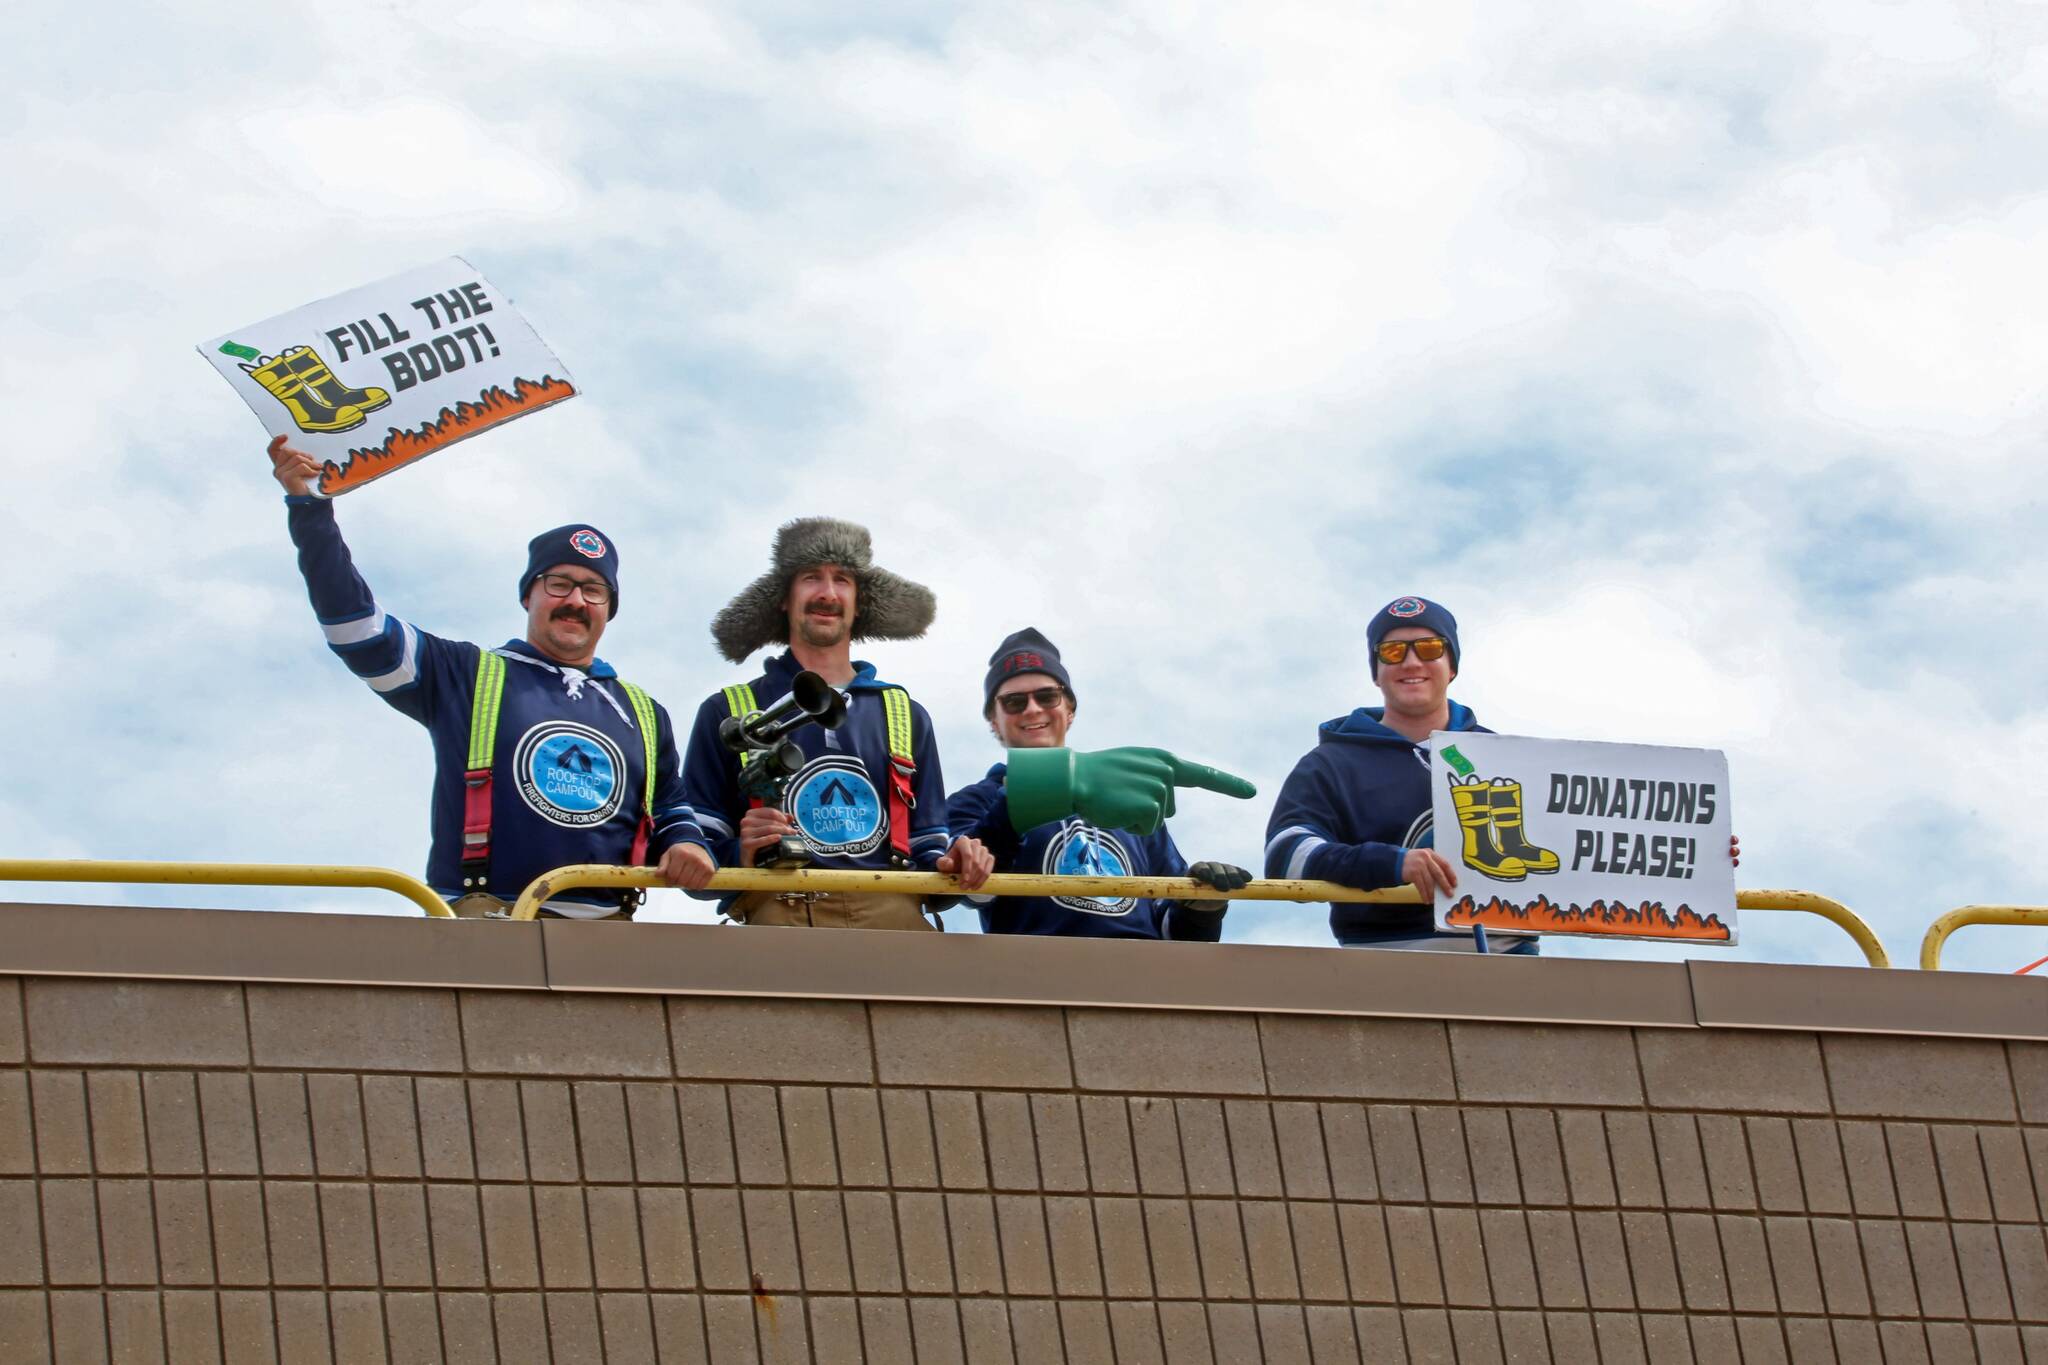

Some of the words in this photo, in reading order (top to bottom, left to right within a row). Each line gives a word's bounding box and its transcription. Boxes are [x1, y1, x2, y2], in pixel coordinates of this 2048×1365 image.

[325, 312, 410, 362] FILL
[411, 281, 493, 330] THE
[381, 322, 500, 393] BOOT!
[547, 767, 601, 788] ROOFTOP
[523, 782, 572, 822] FIREFIGHTERS
[572, 814, 590, 823] FOR
[812, 806, 867, 821] ROOFTOP
[1546, 773, 1716, 825] DONATIONS
[813, 819, 866, 834] CAMPOUT
[845, 844, 861, 853] FOR
[861, 826, 884, 851] CHARITY
[1571, 829, 1696, 879] PLEASE!
